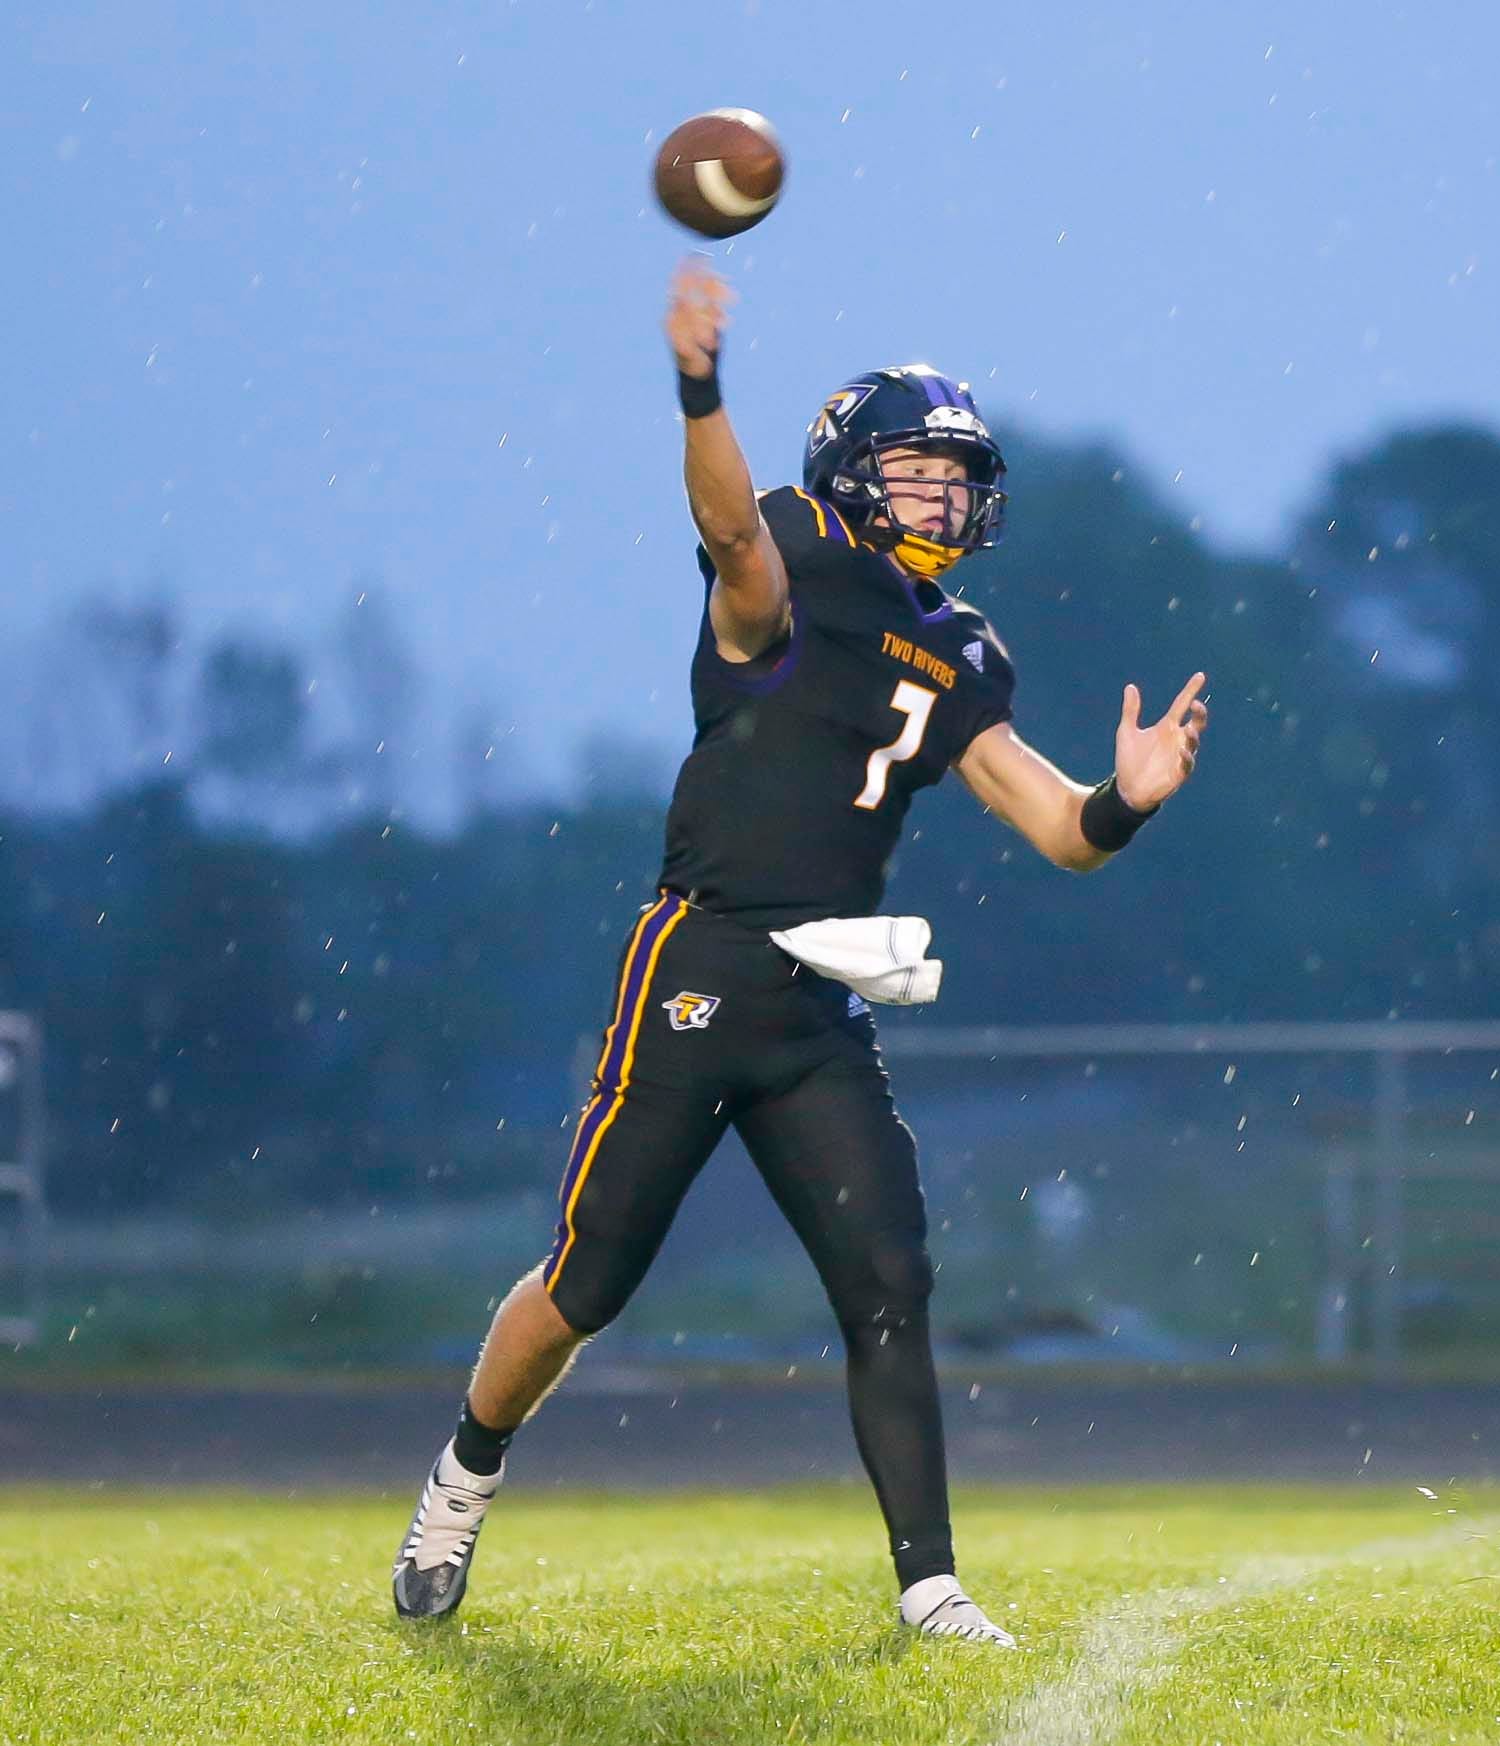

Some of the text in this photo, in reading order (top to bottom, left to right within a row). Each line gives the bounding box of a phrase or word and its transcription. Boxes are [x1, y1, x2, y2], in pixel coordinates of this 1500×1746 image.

[881, 631, 957, 690] TWO RIVERS
[853, 679, 939, 811] 7
